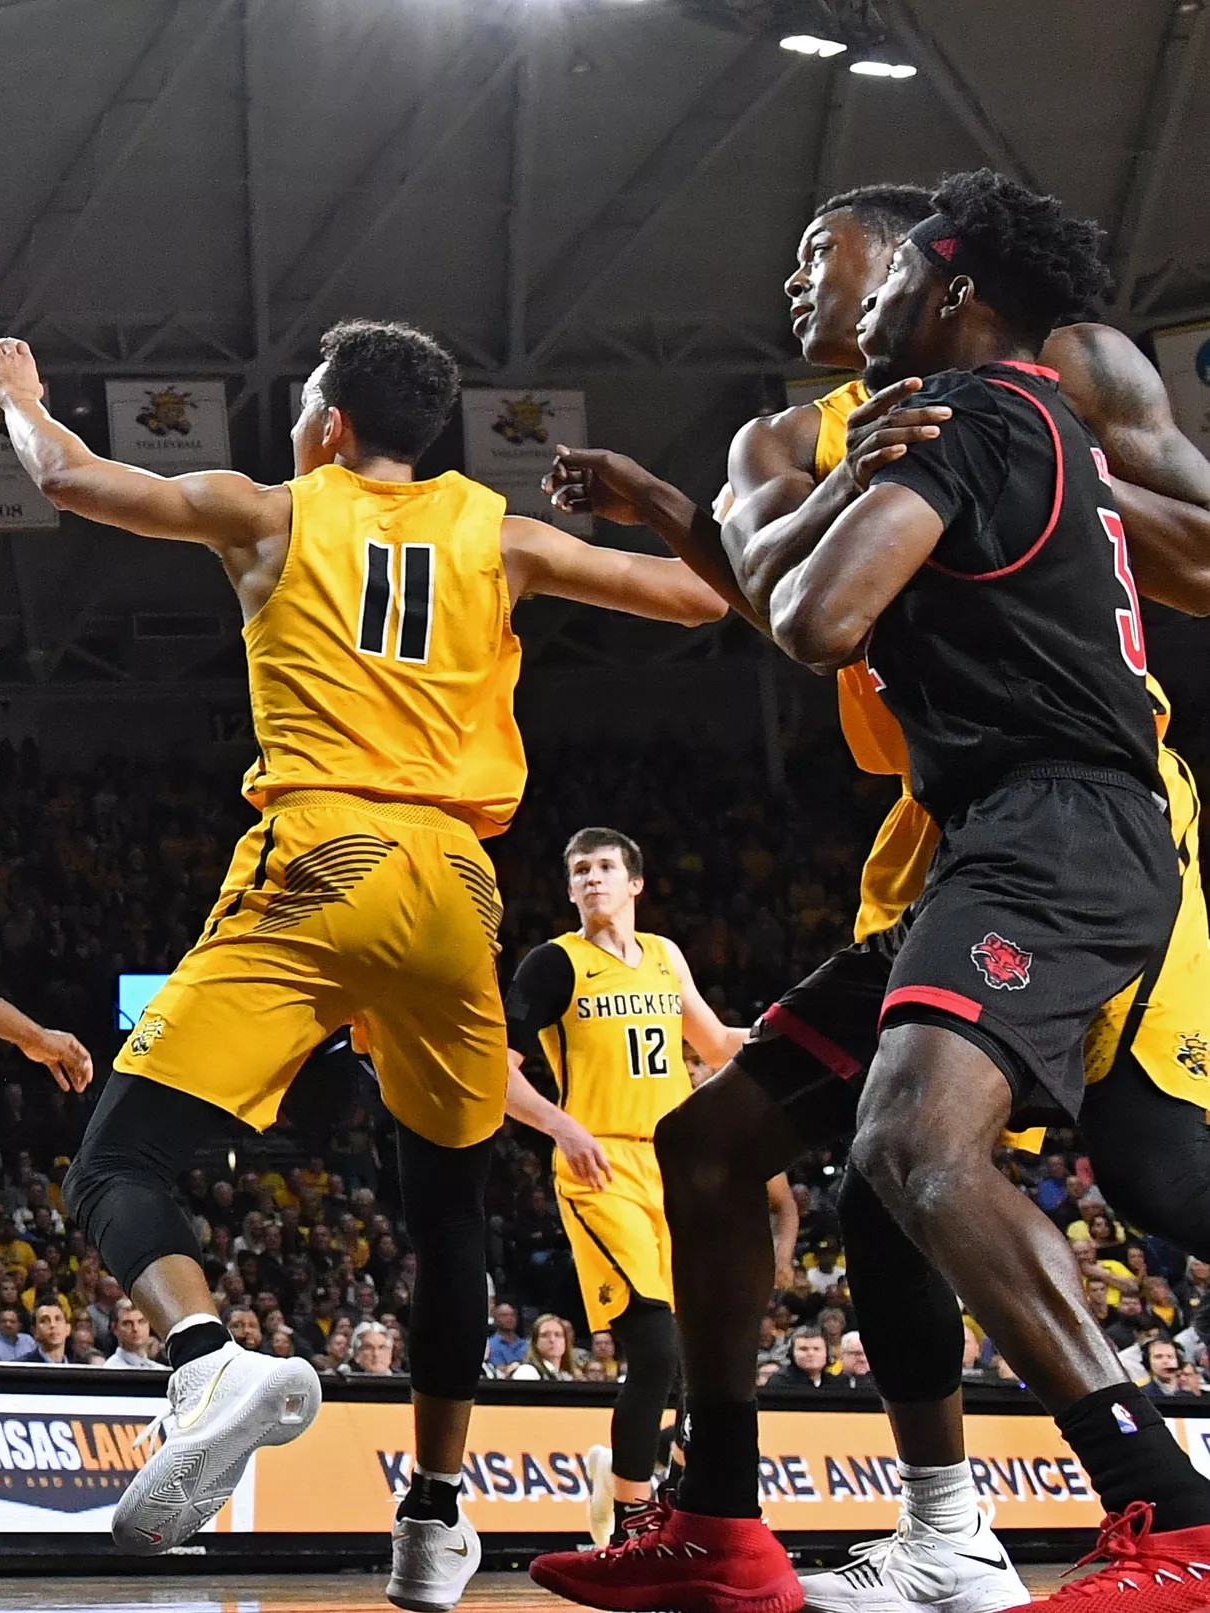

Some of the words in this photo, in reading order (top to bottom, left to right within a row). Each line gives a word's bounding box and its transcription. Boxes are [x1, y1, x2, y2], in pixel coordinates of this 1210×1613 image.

[355, 537, 436, 665] 11
[1096, 507, 1147, 676] 3
[576, 991, 683, 1020] SHOCKERS
[626, 1026, 669, 1079] 12
[824, 1455, 903, 1497] AND
[968, 1456, 1090, 1497] RVICE
